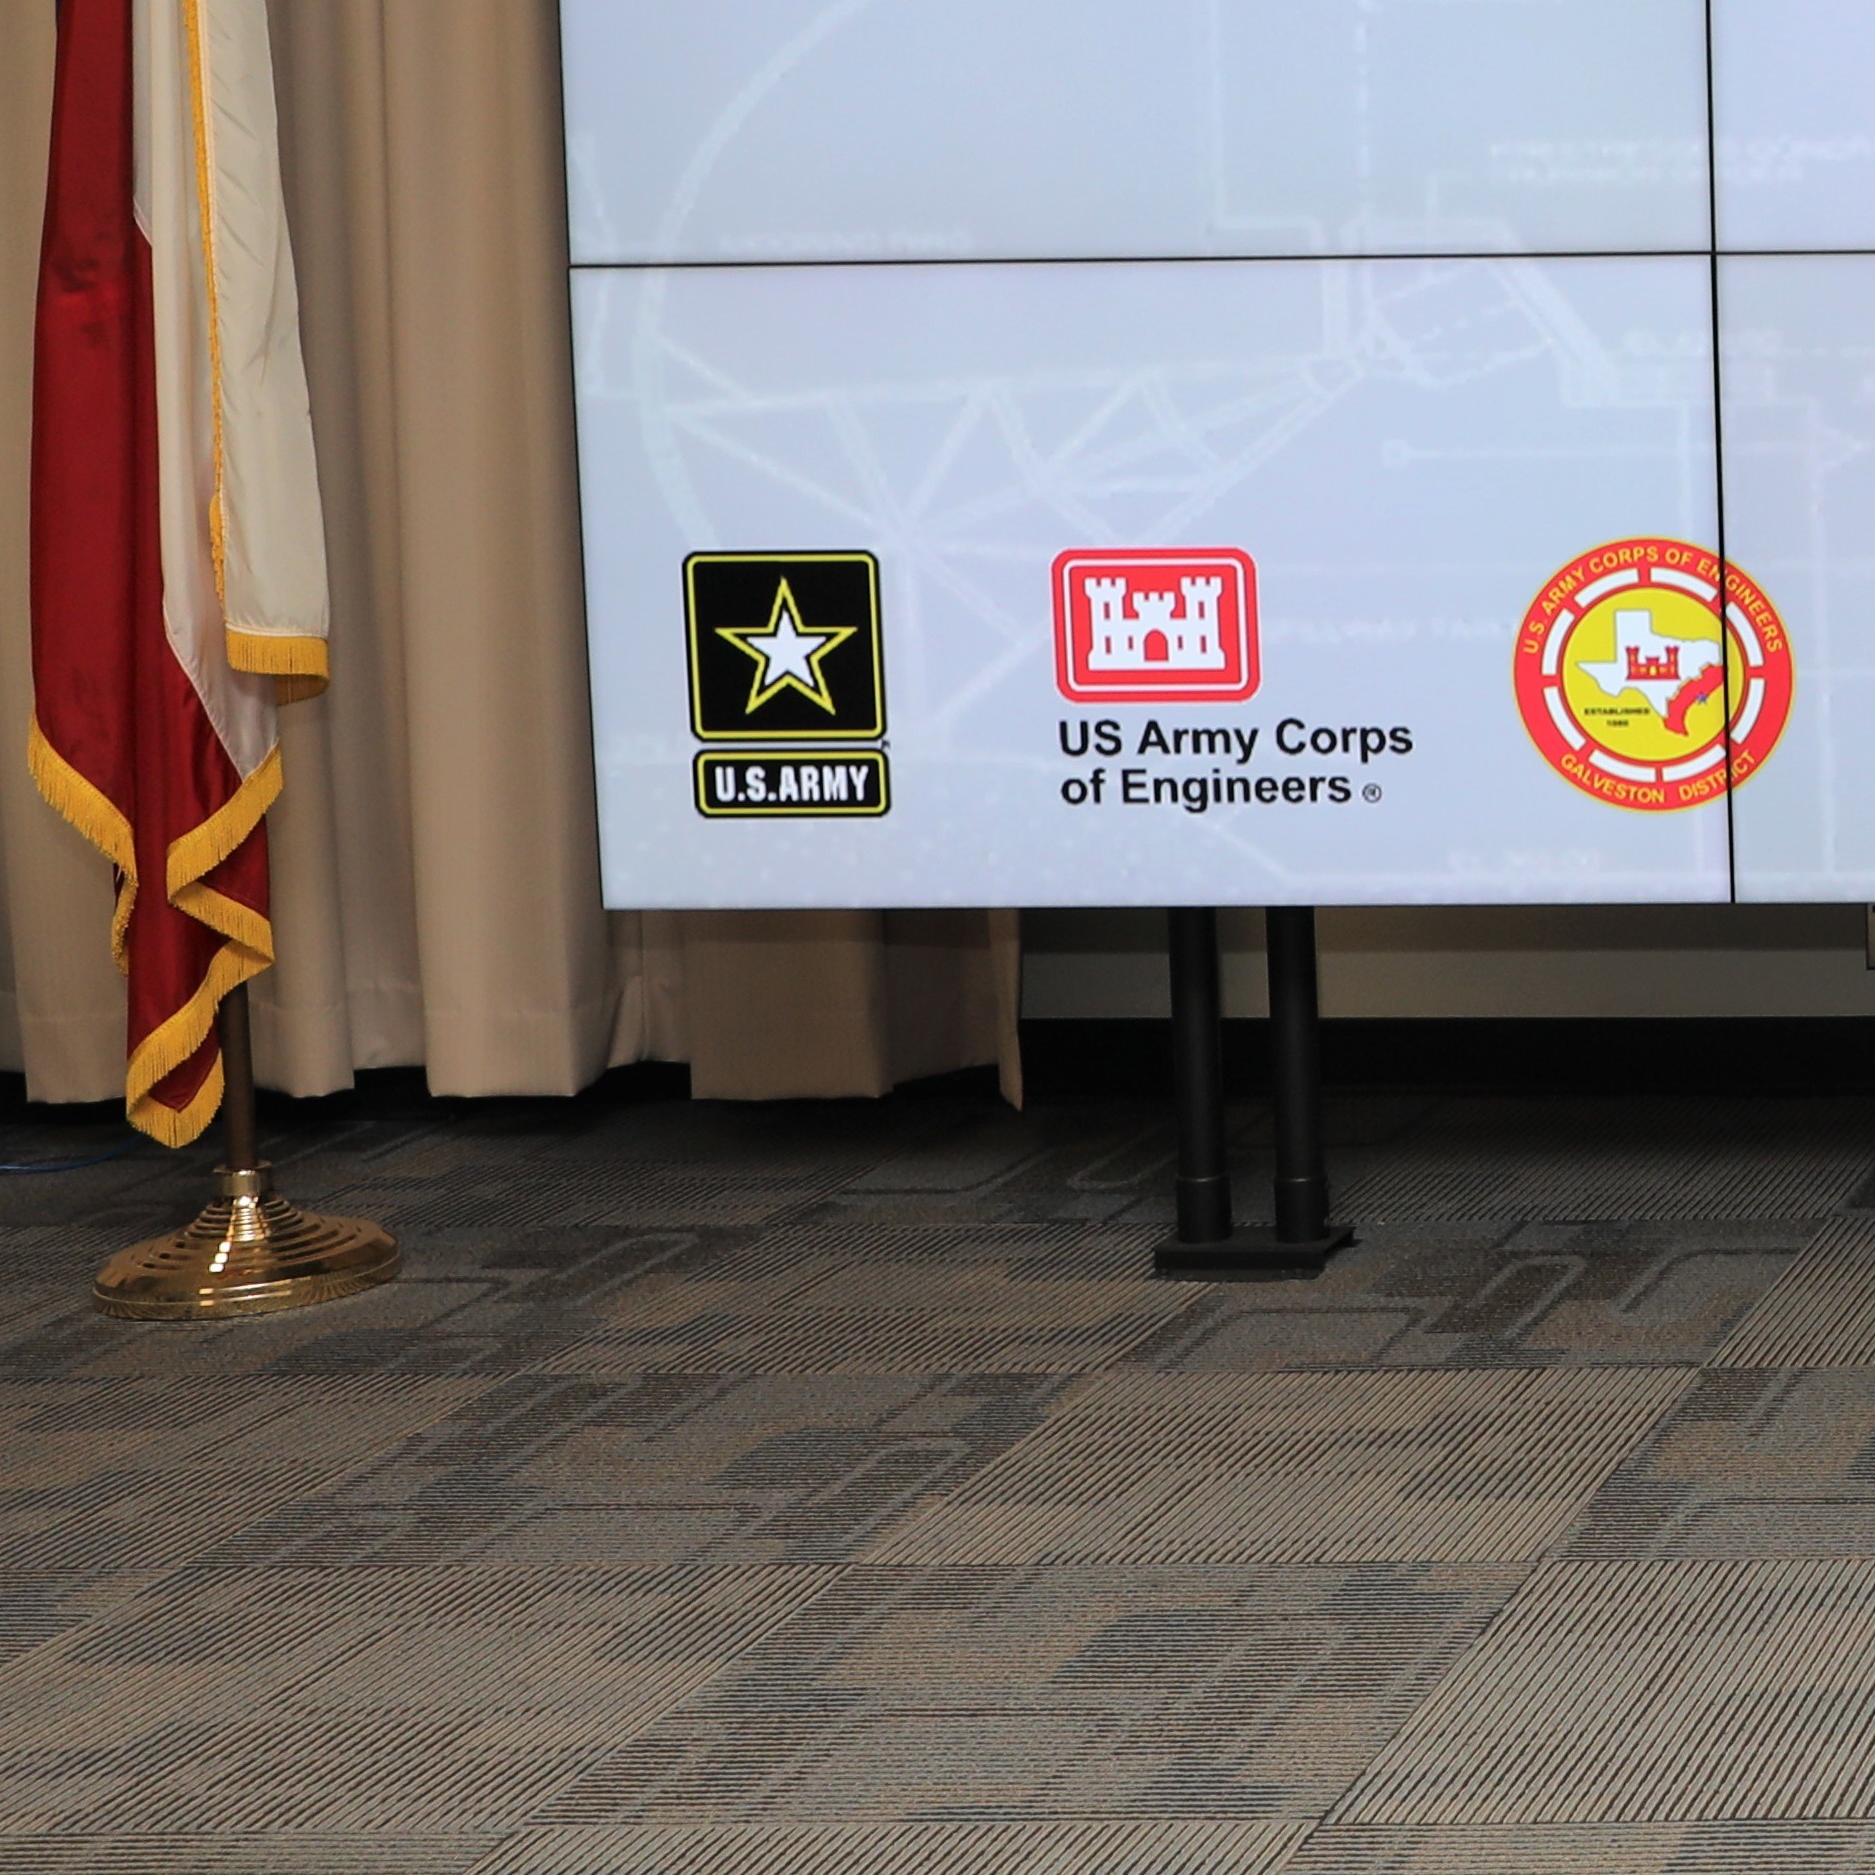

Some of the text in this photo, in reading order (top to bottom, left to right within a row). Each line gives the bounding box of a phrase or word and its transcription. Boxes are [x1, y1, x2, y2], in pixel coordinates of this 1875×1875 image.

[1523, 620, 1545, 655] U.S.
[1542, 568, 1587, 616] ARMY
[1589, 546, 1659, 573] CORPS
[1665, 548, 1692, 566] OF
[1697, 558, 1783, 653] ENGINEERS
[1059, 717, 1413, 764] US Army Corps
[1061, 768, 1351, 813] of Engineers
[1560, 749, 1757, 803] GALVESTON DISTRICT
